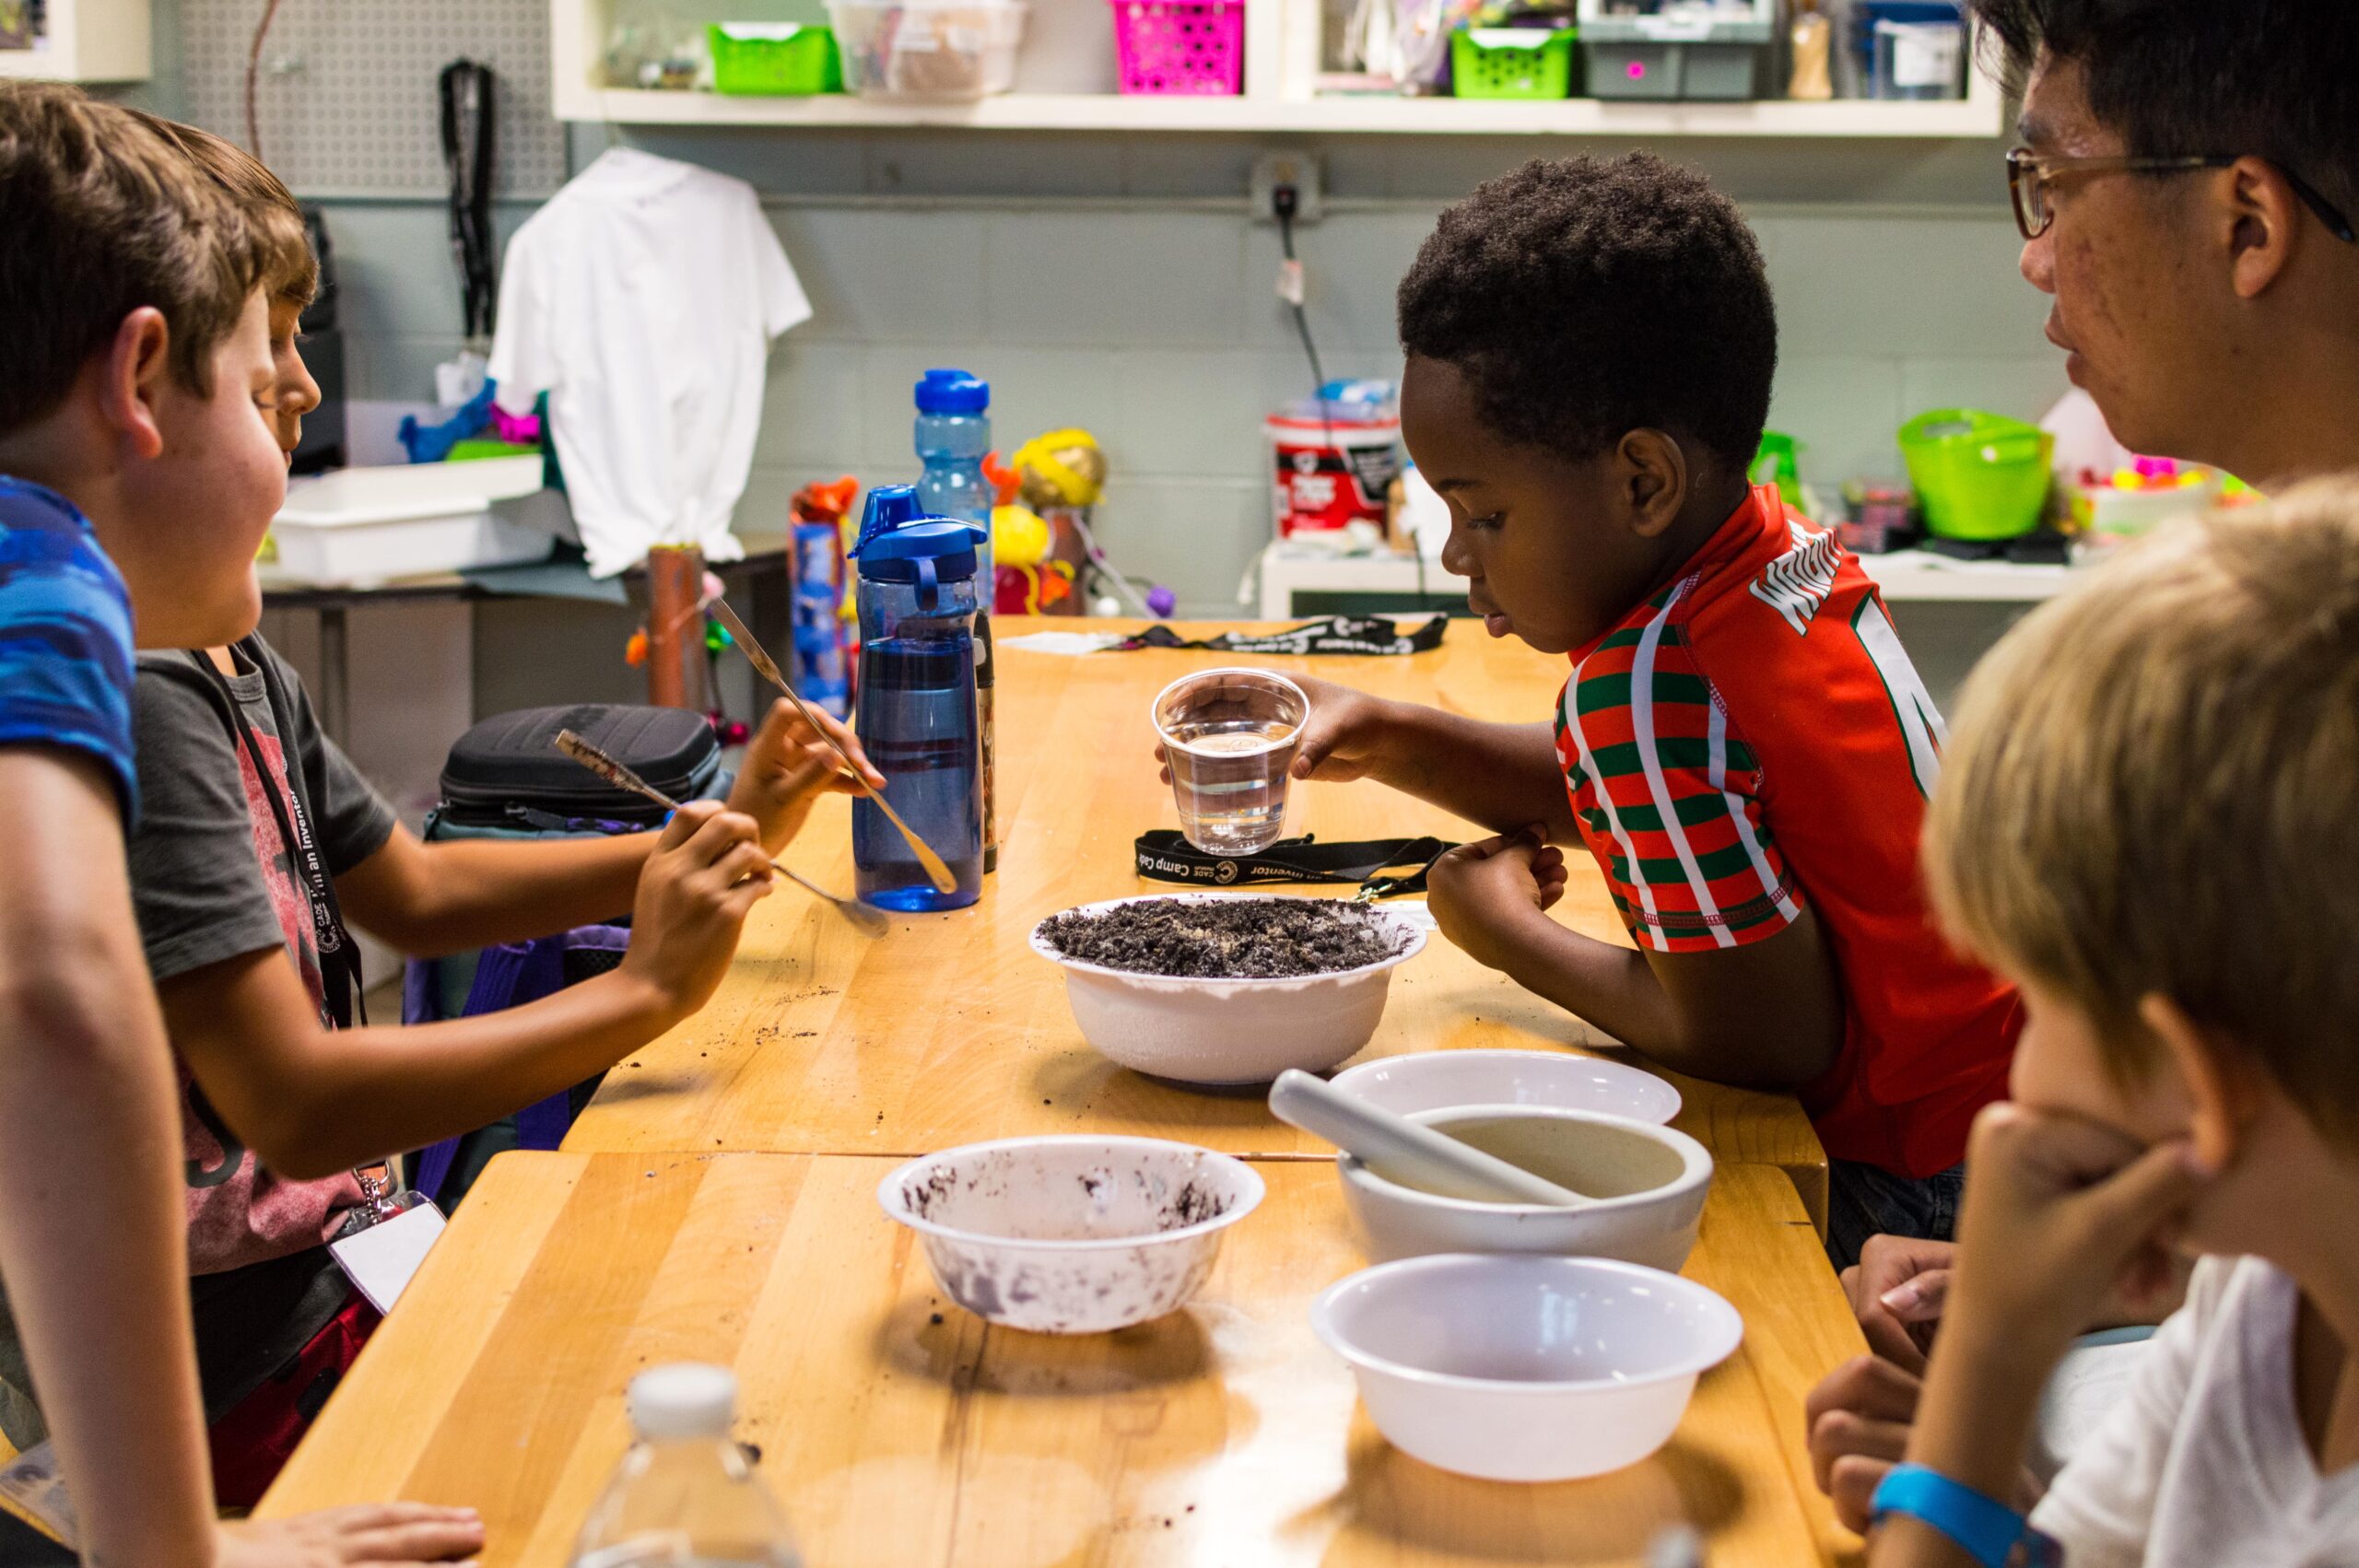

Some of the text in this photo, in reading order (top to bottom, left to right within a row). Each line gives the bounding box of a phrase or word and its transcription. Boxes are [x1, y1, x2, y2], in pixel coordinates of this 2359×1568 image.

[289, 788, 314, 849] Inventor
[306, 851, 321, 872] an
[1156, 857, 1190, 877] Camp
[1193, 870, 1215, 878] CADE
[314, 903, 325, 927] CADE
